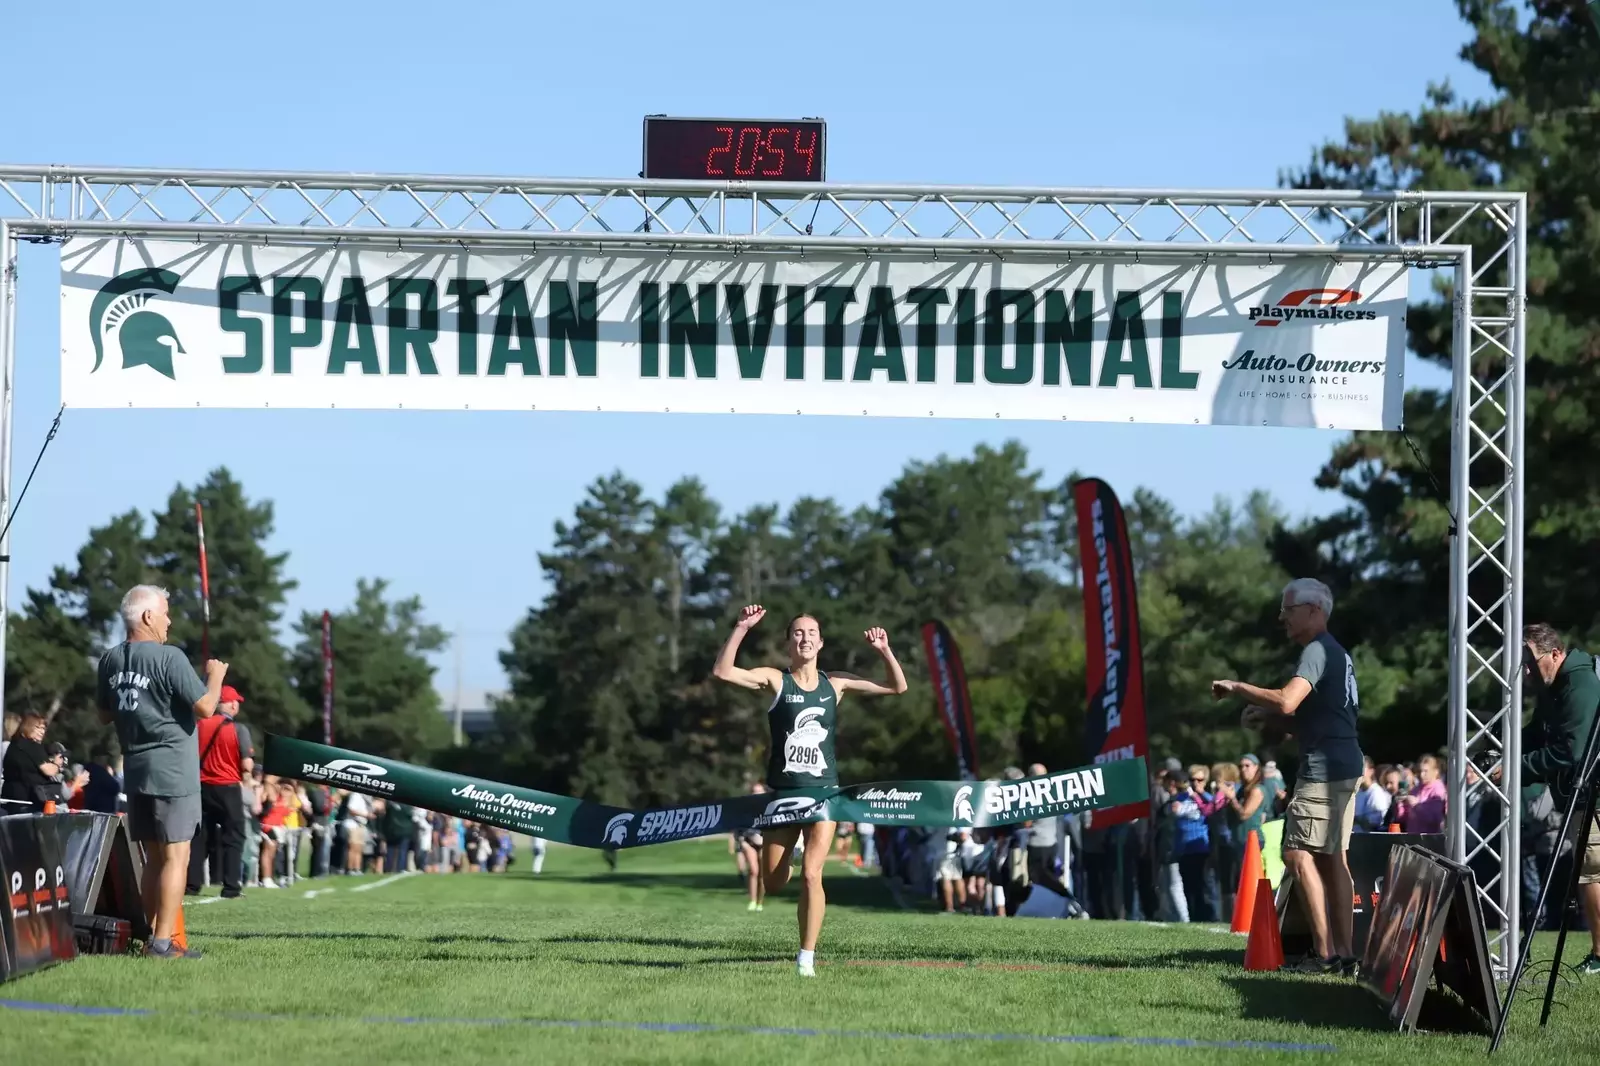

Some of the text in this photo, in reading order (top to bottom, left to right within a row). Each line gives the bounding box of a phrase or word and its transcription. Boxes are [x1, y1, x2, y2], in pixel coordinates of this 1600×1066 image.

[707, 127, 817, 176] 20:54
[1249, 303, 1377, 321] playmakers
[218, 275, 1202, 391] SPARTAN INVITATIONAL
[1222, 350, 1384, 374] Auto-Owners
[1261, 374, 1348, 385] INSURANCE
[1239, 390, 1256, 398] LIFE
[1265, 391, 1291, 399] HOME
[1327, 393, 1369, 401] BUSINESS
[117, 688, 139, 711] XC
[788, 745, 819, 765] 2896
[302, 763, 396, 791] playmakers
[451, 784, 557, 815] Auto-Owners
[856, 788, 923, 801] Auto-Owners
[984, 768, 1105, 814] SPARTAN
[475, 801, 533, 820] INSURANCE
[870, 801, 907, 809] INSURANCE
[996, 798, 1099, 821] INVITATIONAL
[516, 822, 544, 832] BUSINESS
[637, 804, 722, 836] SPARTAN
